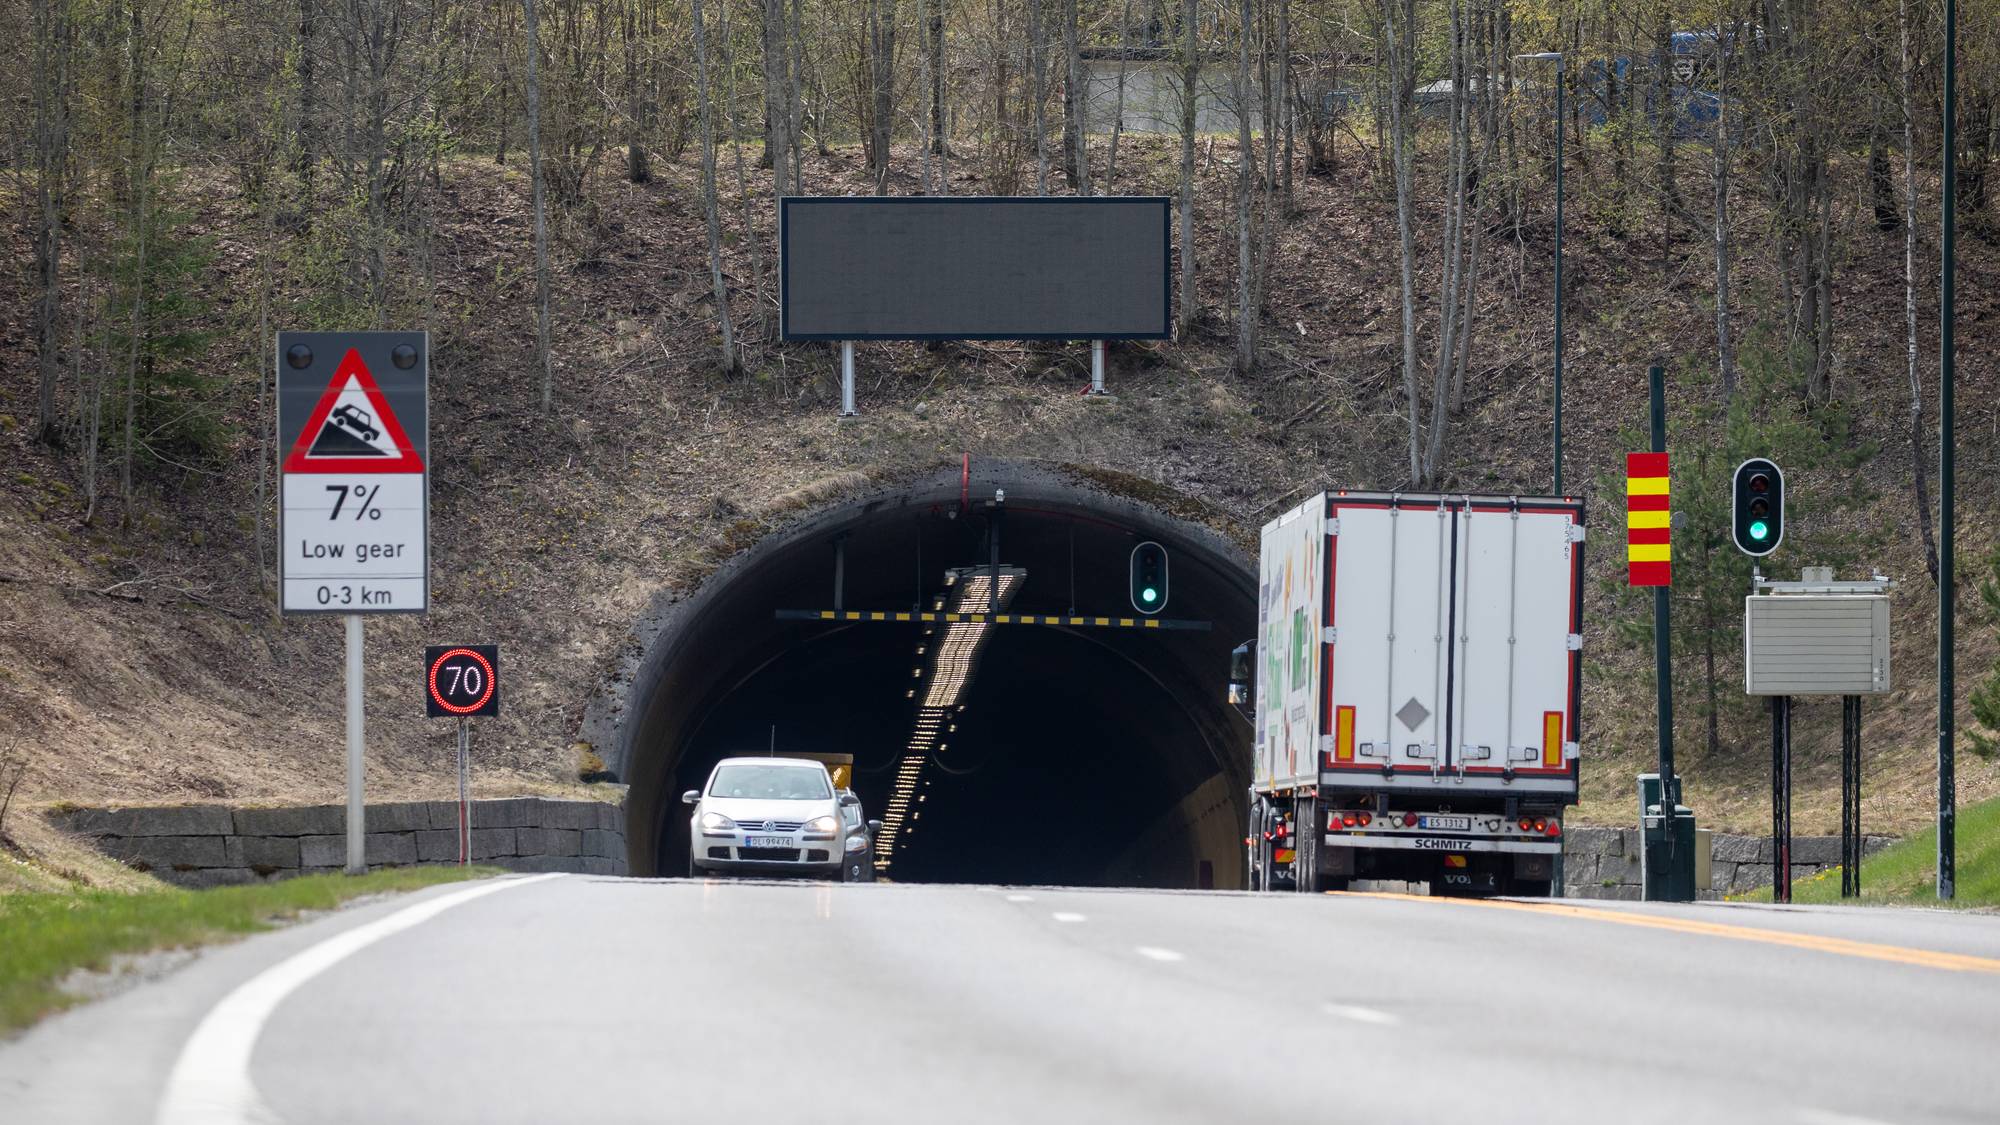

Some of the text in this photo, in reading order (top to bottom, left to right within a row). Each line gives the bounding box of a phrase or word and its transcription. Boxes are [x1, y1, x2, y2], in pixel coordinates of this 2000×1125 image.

[326, 485, 381, 521] 7%
[302, 540, 405, 563] Low gear
[317, 586, 392, 605] 0-3 km
[446, 666, 481, 695] 70
[1430, 819, 1464, 828] ES 1312
[1415, 839, 1472, 850] SCHMITZ
